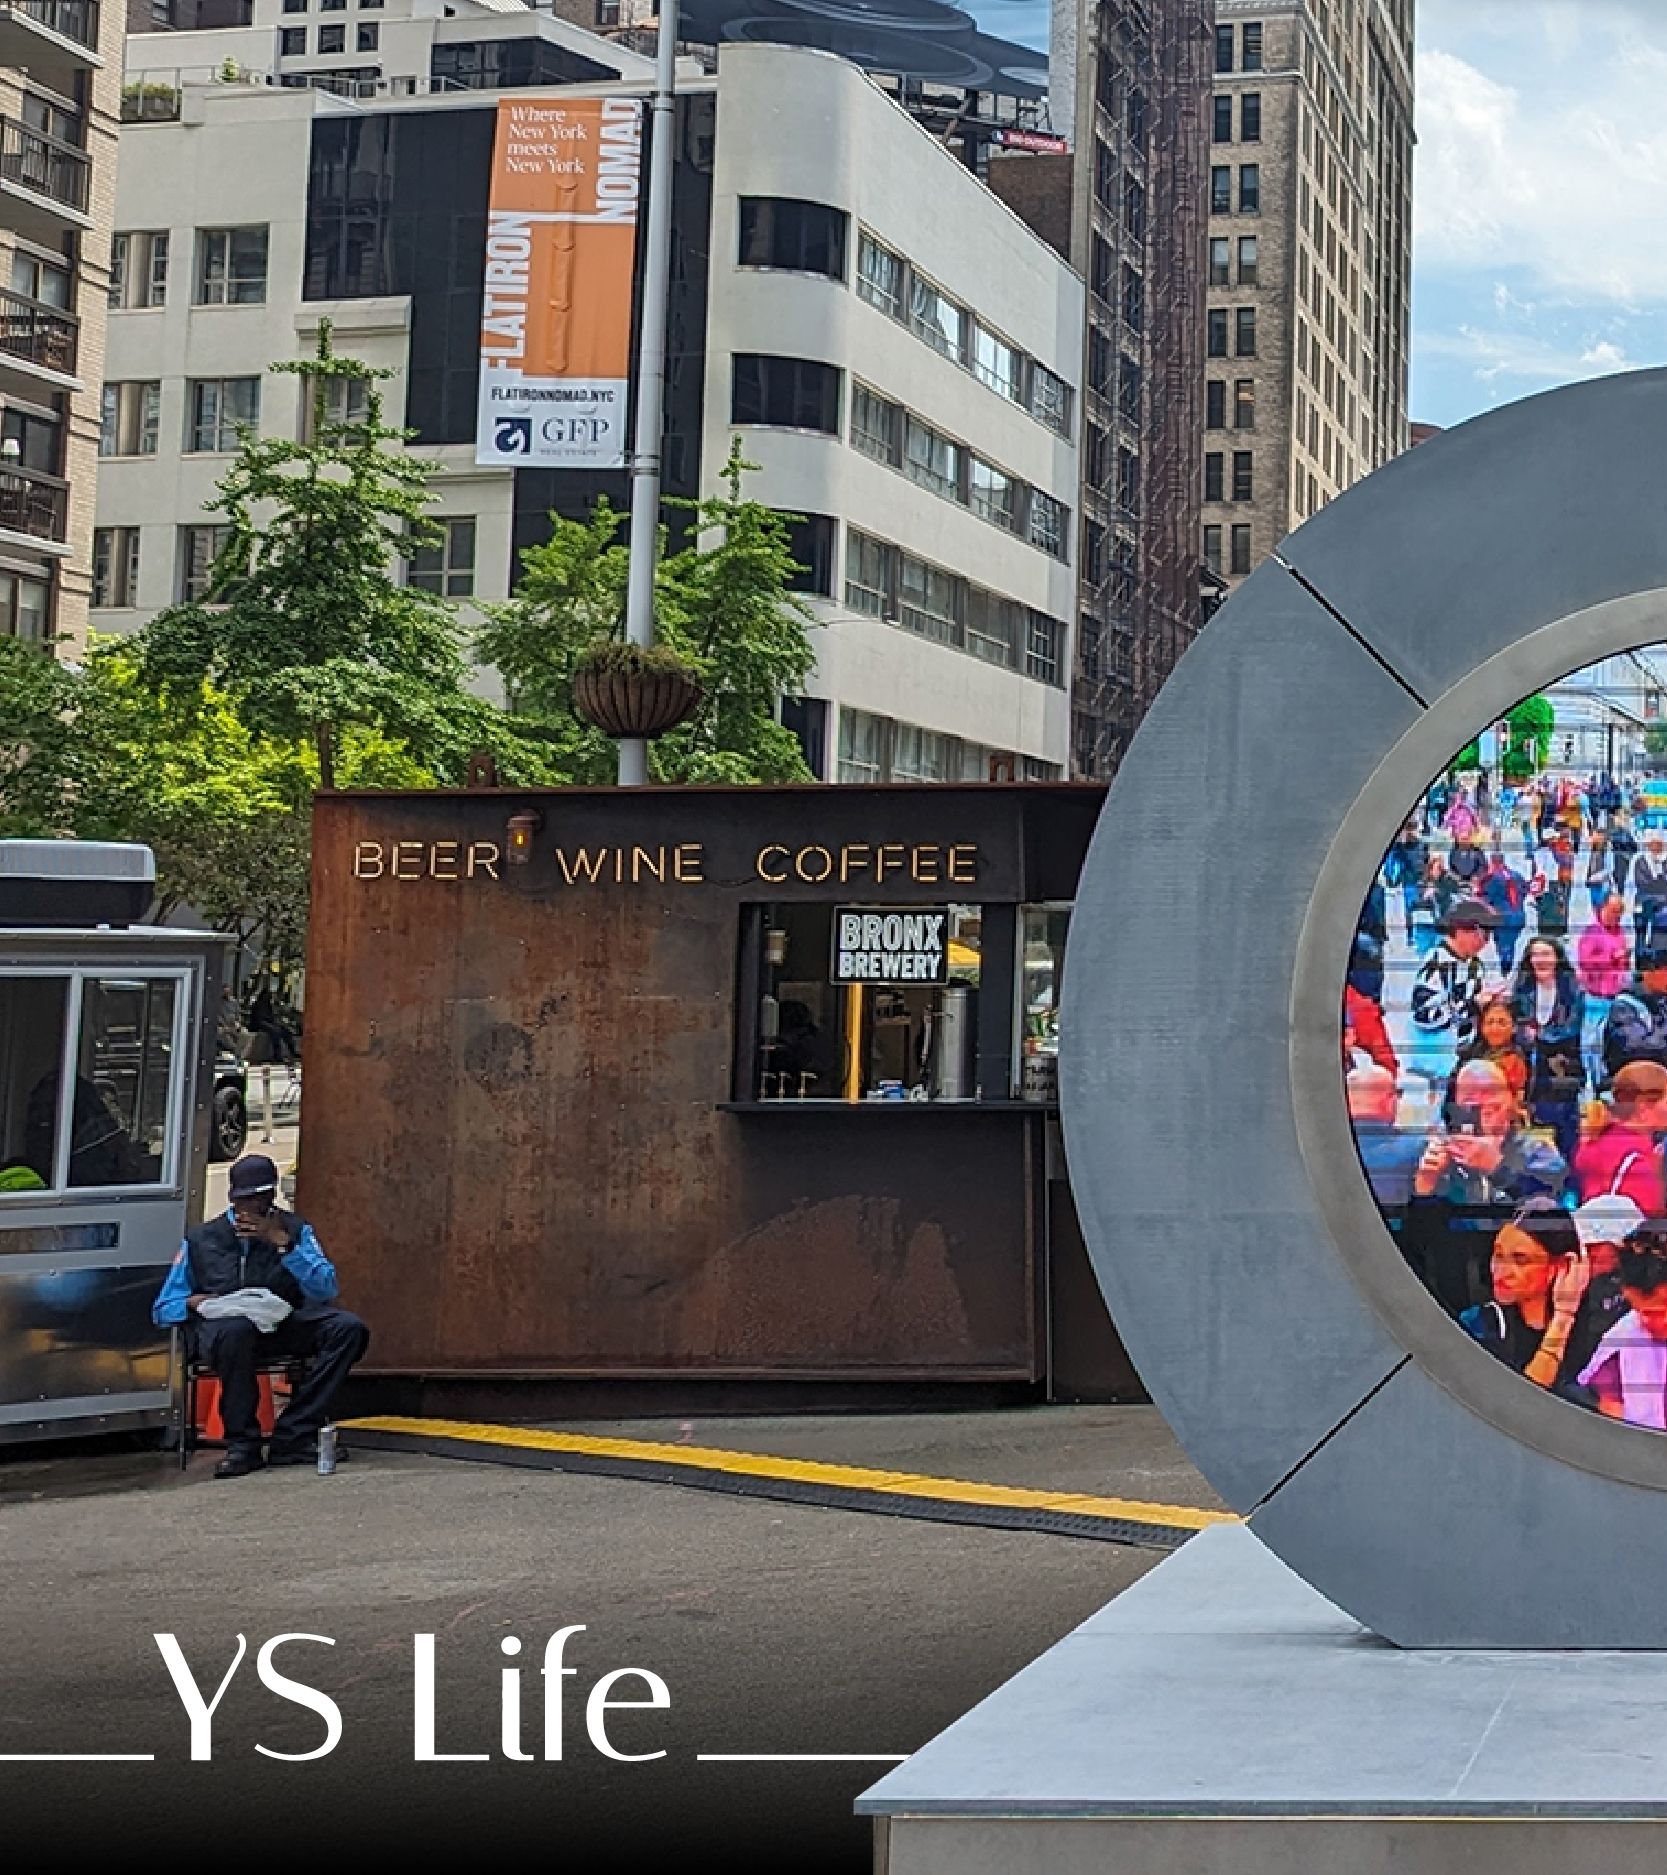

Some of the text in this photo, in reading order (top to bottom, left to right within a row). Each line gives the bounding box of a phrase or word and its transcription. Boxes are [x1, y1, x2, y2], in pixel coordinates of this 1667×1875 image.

[511, 106, 567, 121] Where
[509, 123, 588, 140] New York
[507, 143, 559, 156] meets
[596, 98, 642, 223] NOMAD
[506, 157, 586, 174] New York
[481, 211, 531, 376] FLATIRON
[542, 418, 610, 442] GFP
[354, 841, 978, 884] BEER WINE COFFEE
[839, 914, 945, 950] BRONX
[838, 951, 943, 979] BREWERY
